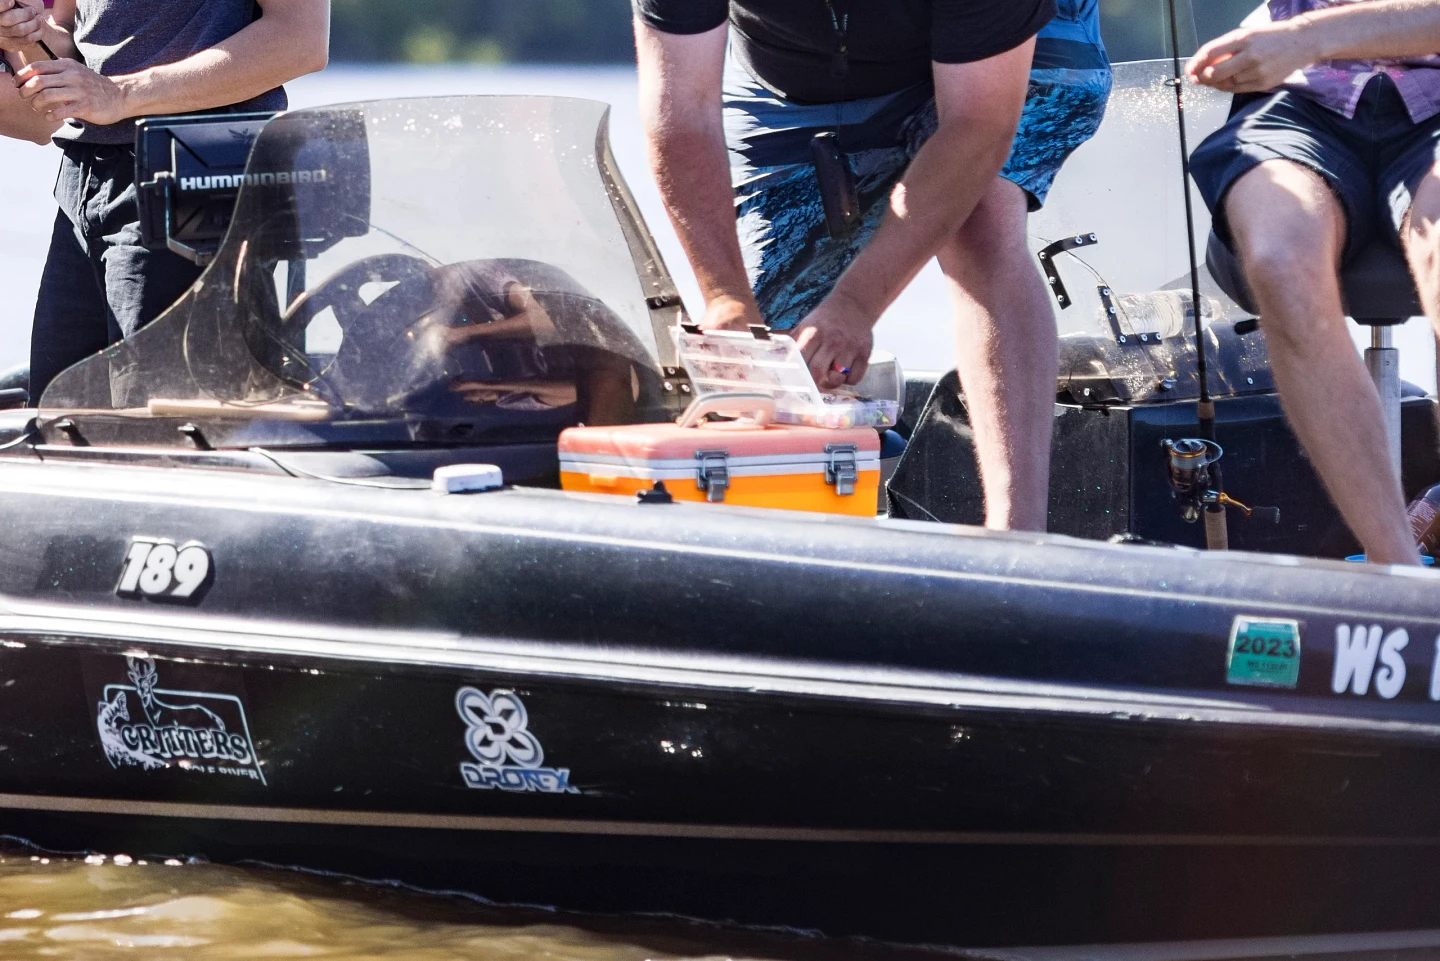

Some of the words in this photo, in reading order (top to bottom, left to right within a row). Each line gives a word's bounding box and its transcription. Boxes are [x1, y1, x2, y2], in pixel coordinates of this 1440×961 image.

[180, 168, 327, 191] HUMMINBIRD
[117, 538, 213, 603] 189
[1236, 635, 1296, 658] 2023
[1332, 624, 1409, 699] WS
[121, 724, 252, 765] CRITTERS
